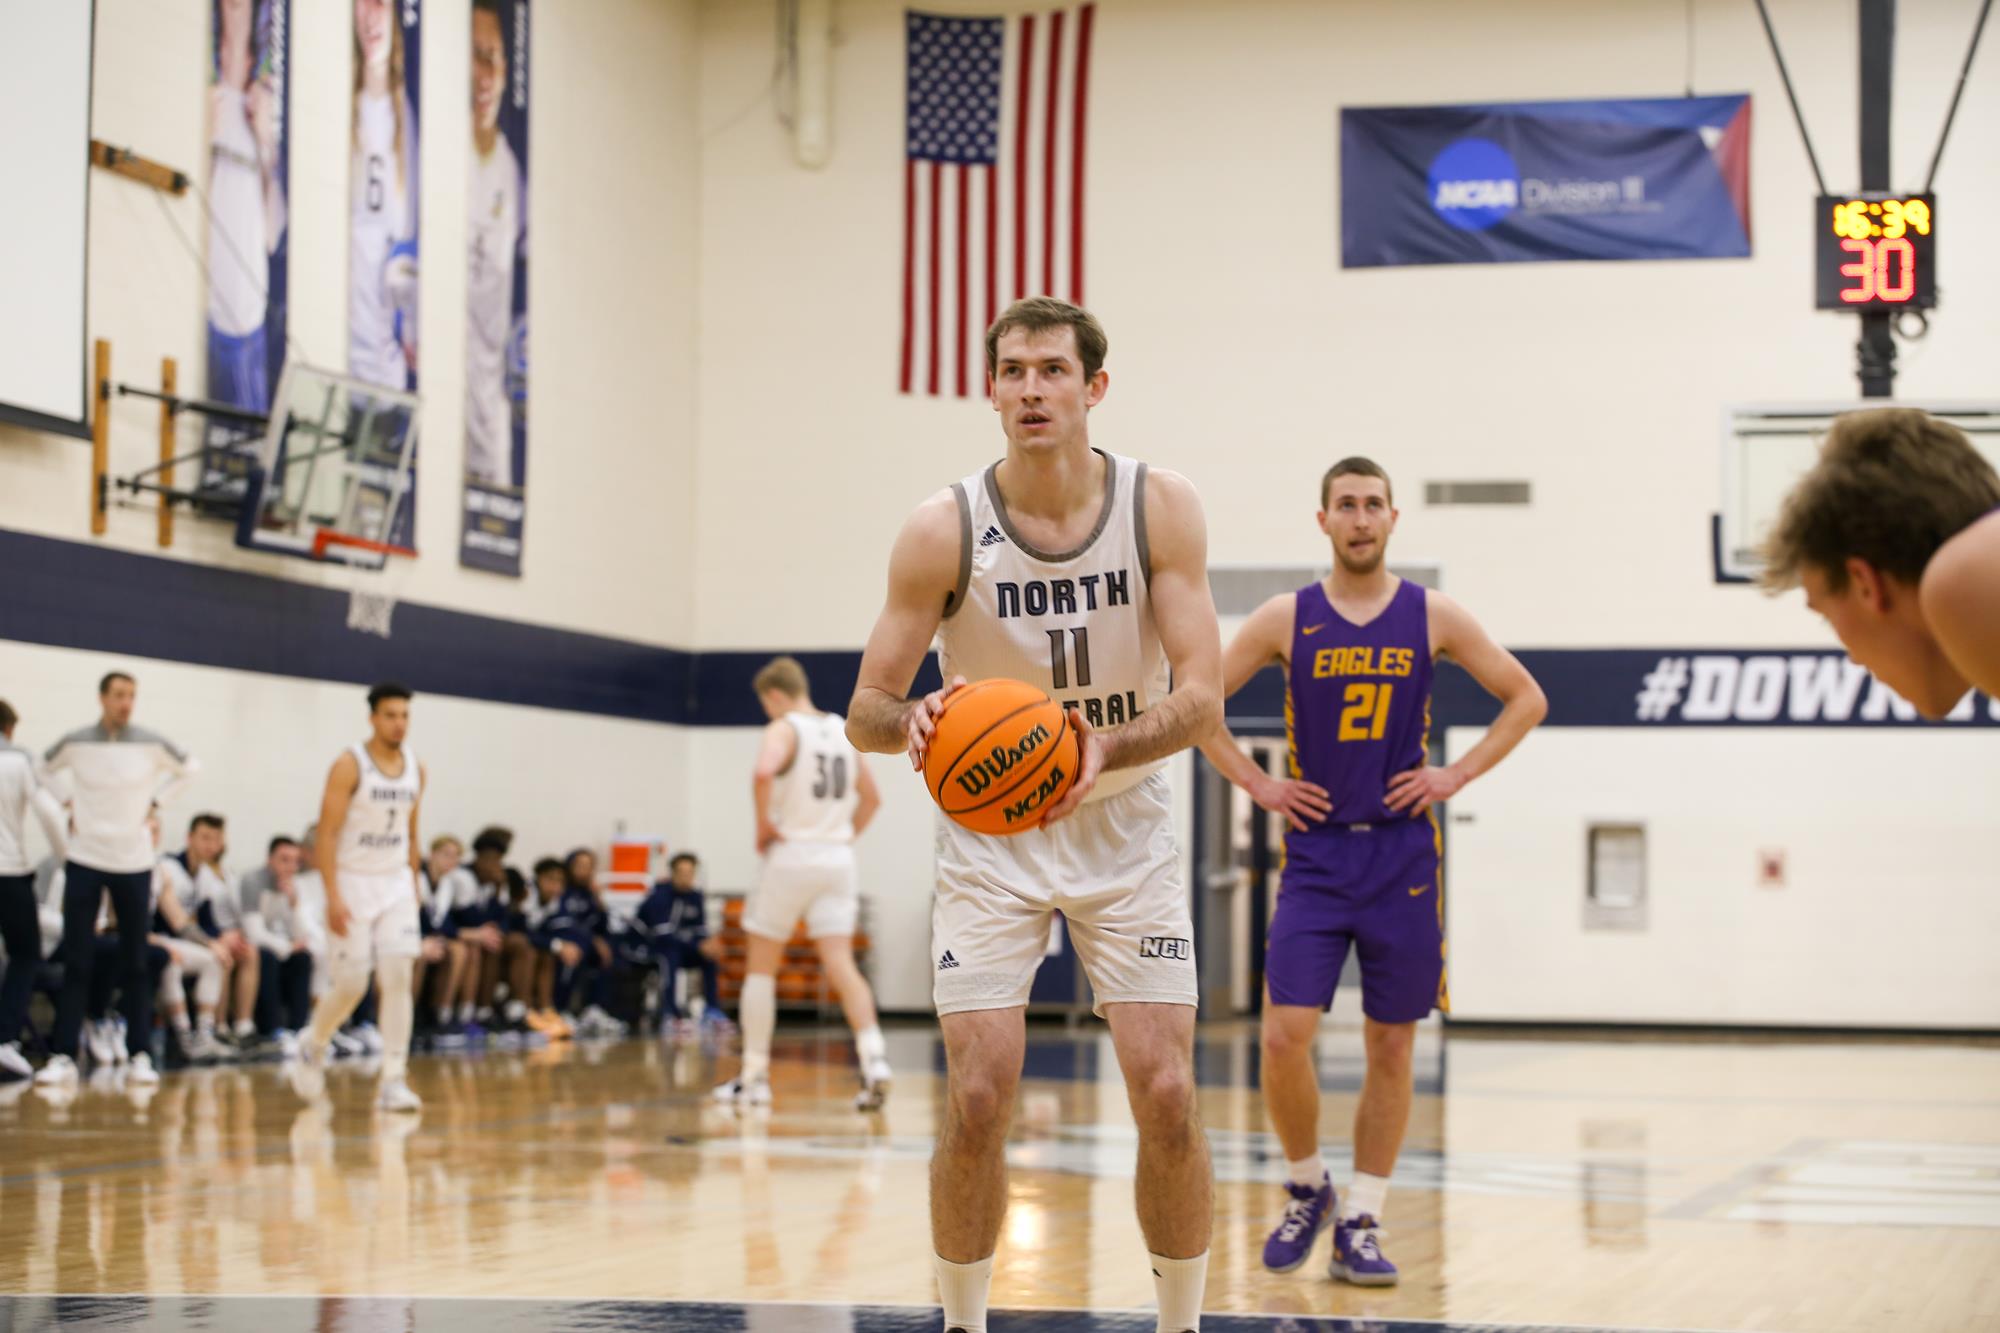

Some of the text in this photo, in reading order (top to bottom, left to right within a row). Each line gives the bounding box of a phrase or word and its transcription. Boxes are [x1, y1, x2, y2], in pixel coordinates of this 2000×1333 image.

[368, 153, 385, 214] 6
[1840, 238, 1916, 303] 30
[995, 569, 1130, 619] NORTH
[1045, 626, 1091, 690] 11
[1312, 646, 1414, 679] EAGLES
[1338, 682, 1394, 742] 21
[813, 752, 847, 799] 30
[956, 722, 1051, 797] Wilson
[1003, 766, 1066, 824] NCAA
[1140, 936, 1190, 960] NCU
